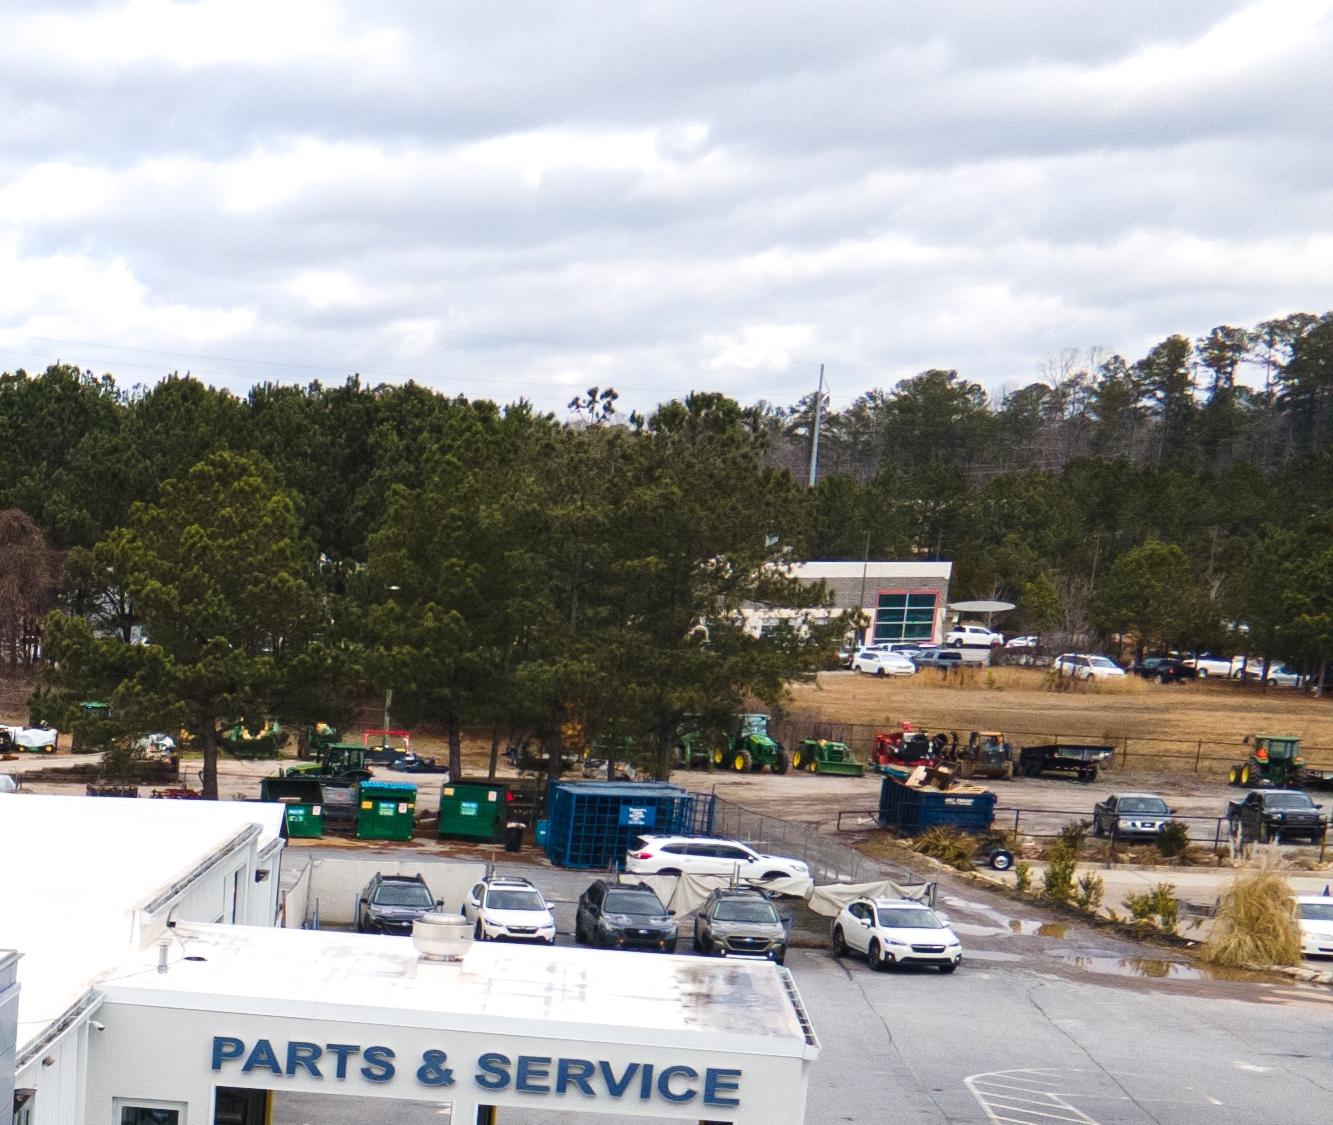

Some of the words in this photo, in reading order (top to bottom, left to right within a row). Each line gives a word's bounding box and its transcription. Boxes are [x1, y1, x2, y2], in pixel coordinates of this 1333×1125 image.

[211, 1035, 397, 1083] PARTS
[416, 1048, 457, 1086] &
[474, 1052, 744, 1107] SERVICE
